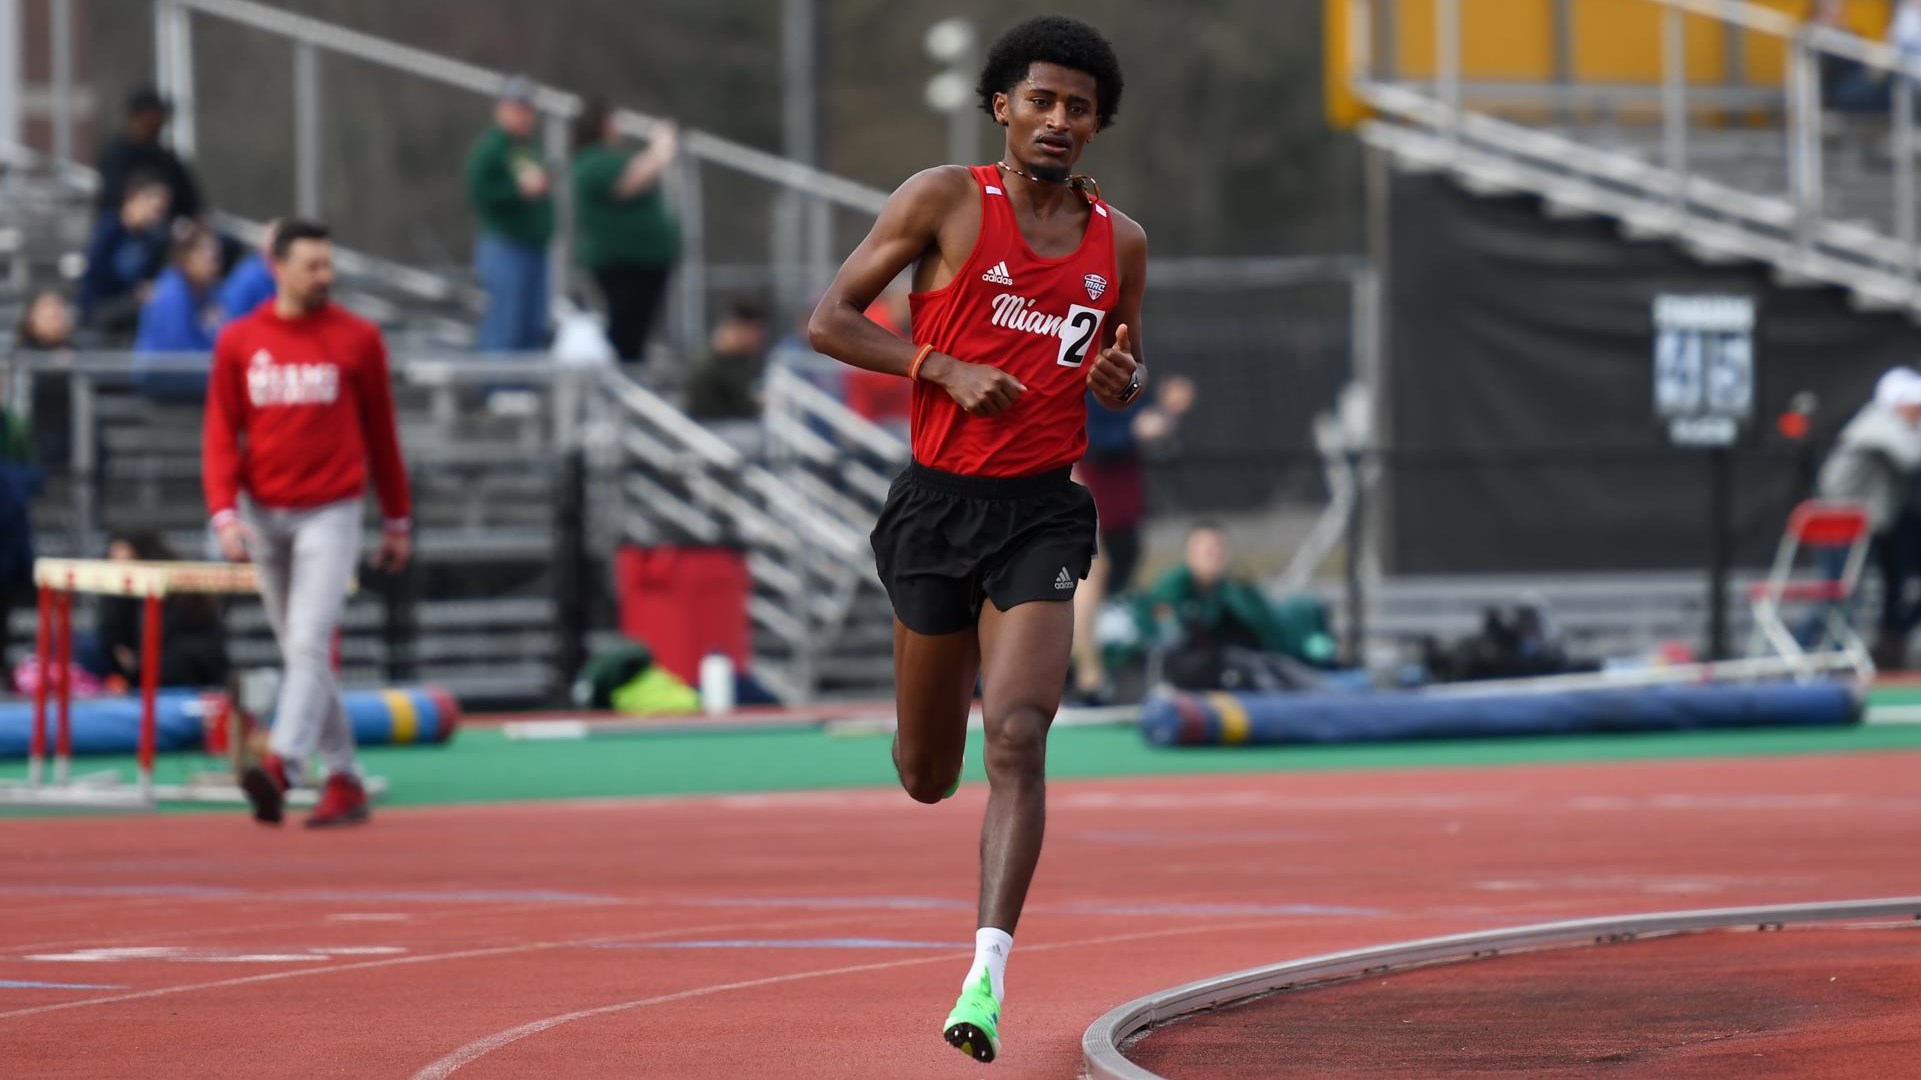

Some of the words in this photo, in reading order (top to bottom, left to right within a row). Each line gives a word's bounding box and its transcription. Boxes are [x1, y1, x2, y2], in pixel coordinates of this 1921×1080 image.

[982, 274, 1013, 286] adidas
[1085, 280, 1105, 292] MAC
[992, 293, 1069, 339] Miam
[1063, 311, 1098, 364] 2
